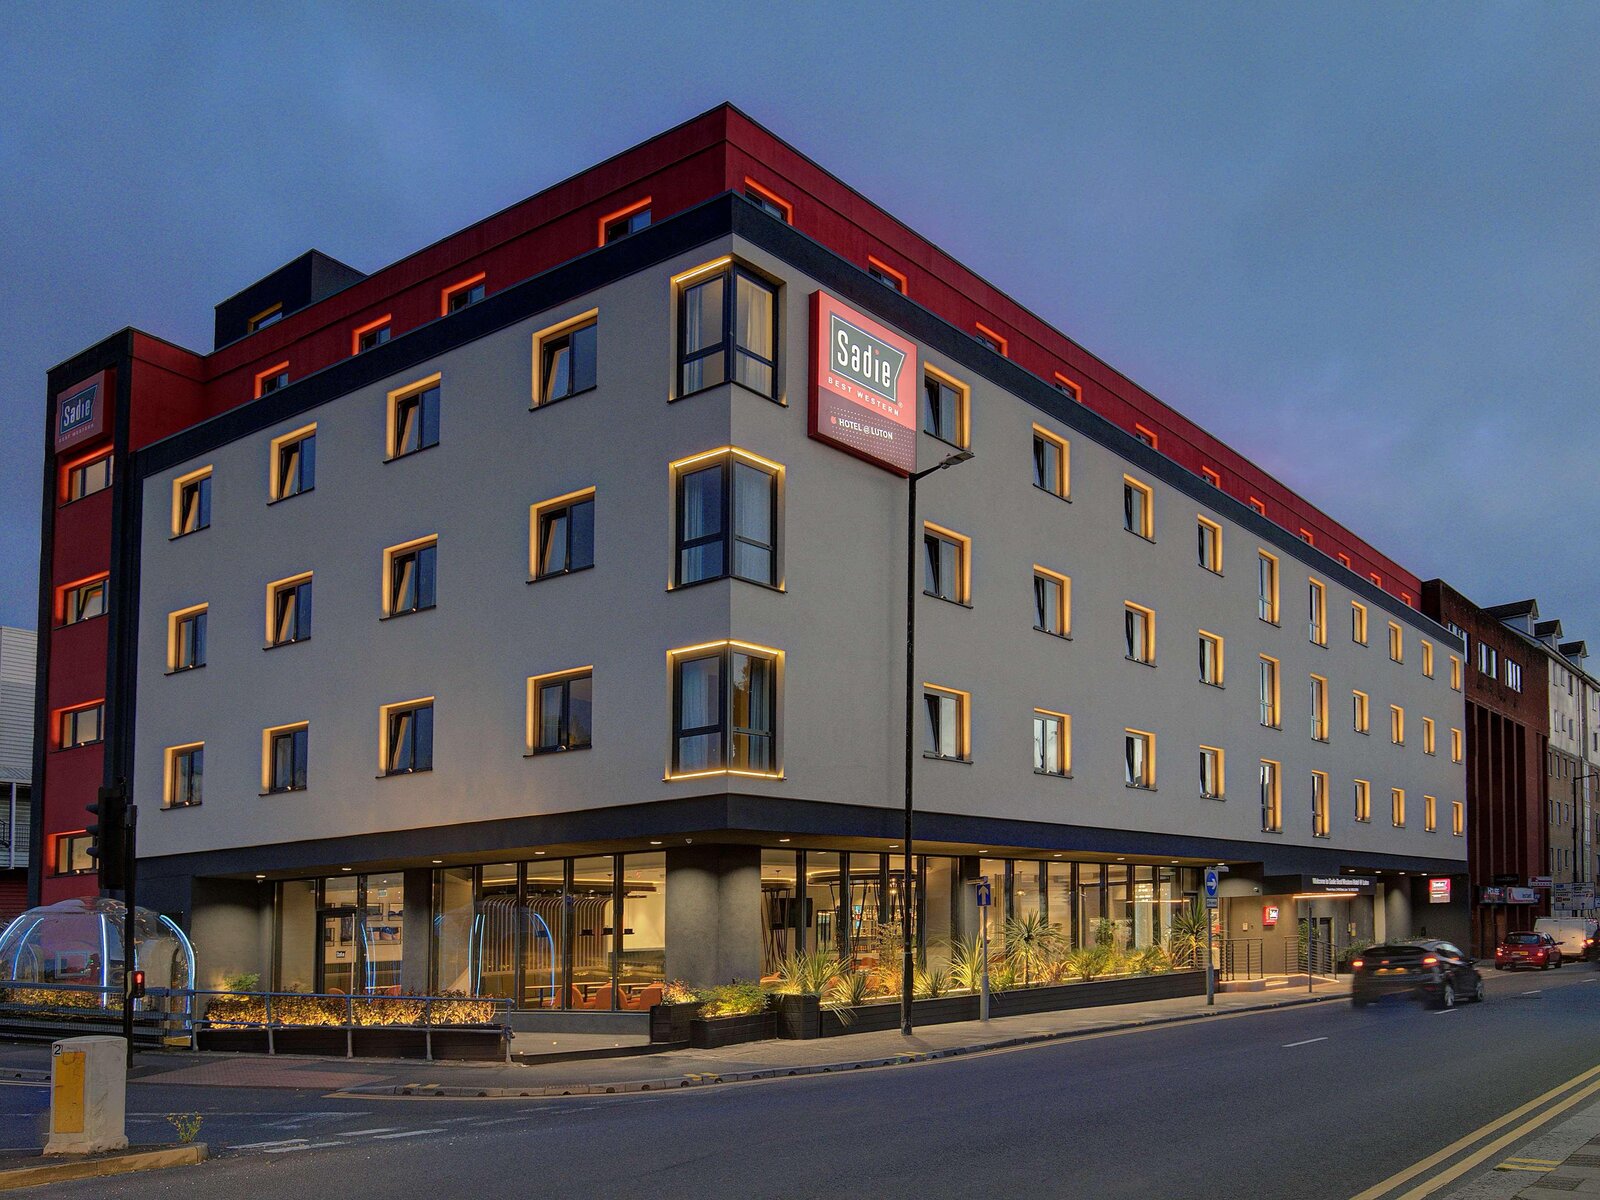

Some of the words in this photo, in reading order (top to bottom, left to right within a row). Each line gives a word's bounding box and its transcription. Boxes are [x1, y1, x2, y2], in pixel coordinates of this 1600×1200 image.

[837, 329, 891, 388] Sadie
[63, 398, 91, 427] Sadie
[828, 376, 852, 393] BEST
[856, 390, 899, 417] WESTERN
[54, 1044, 61, 1055] 2
